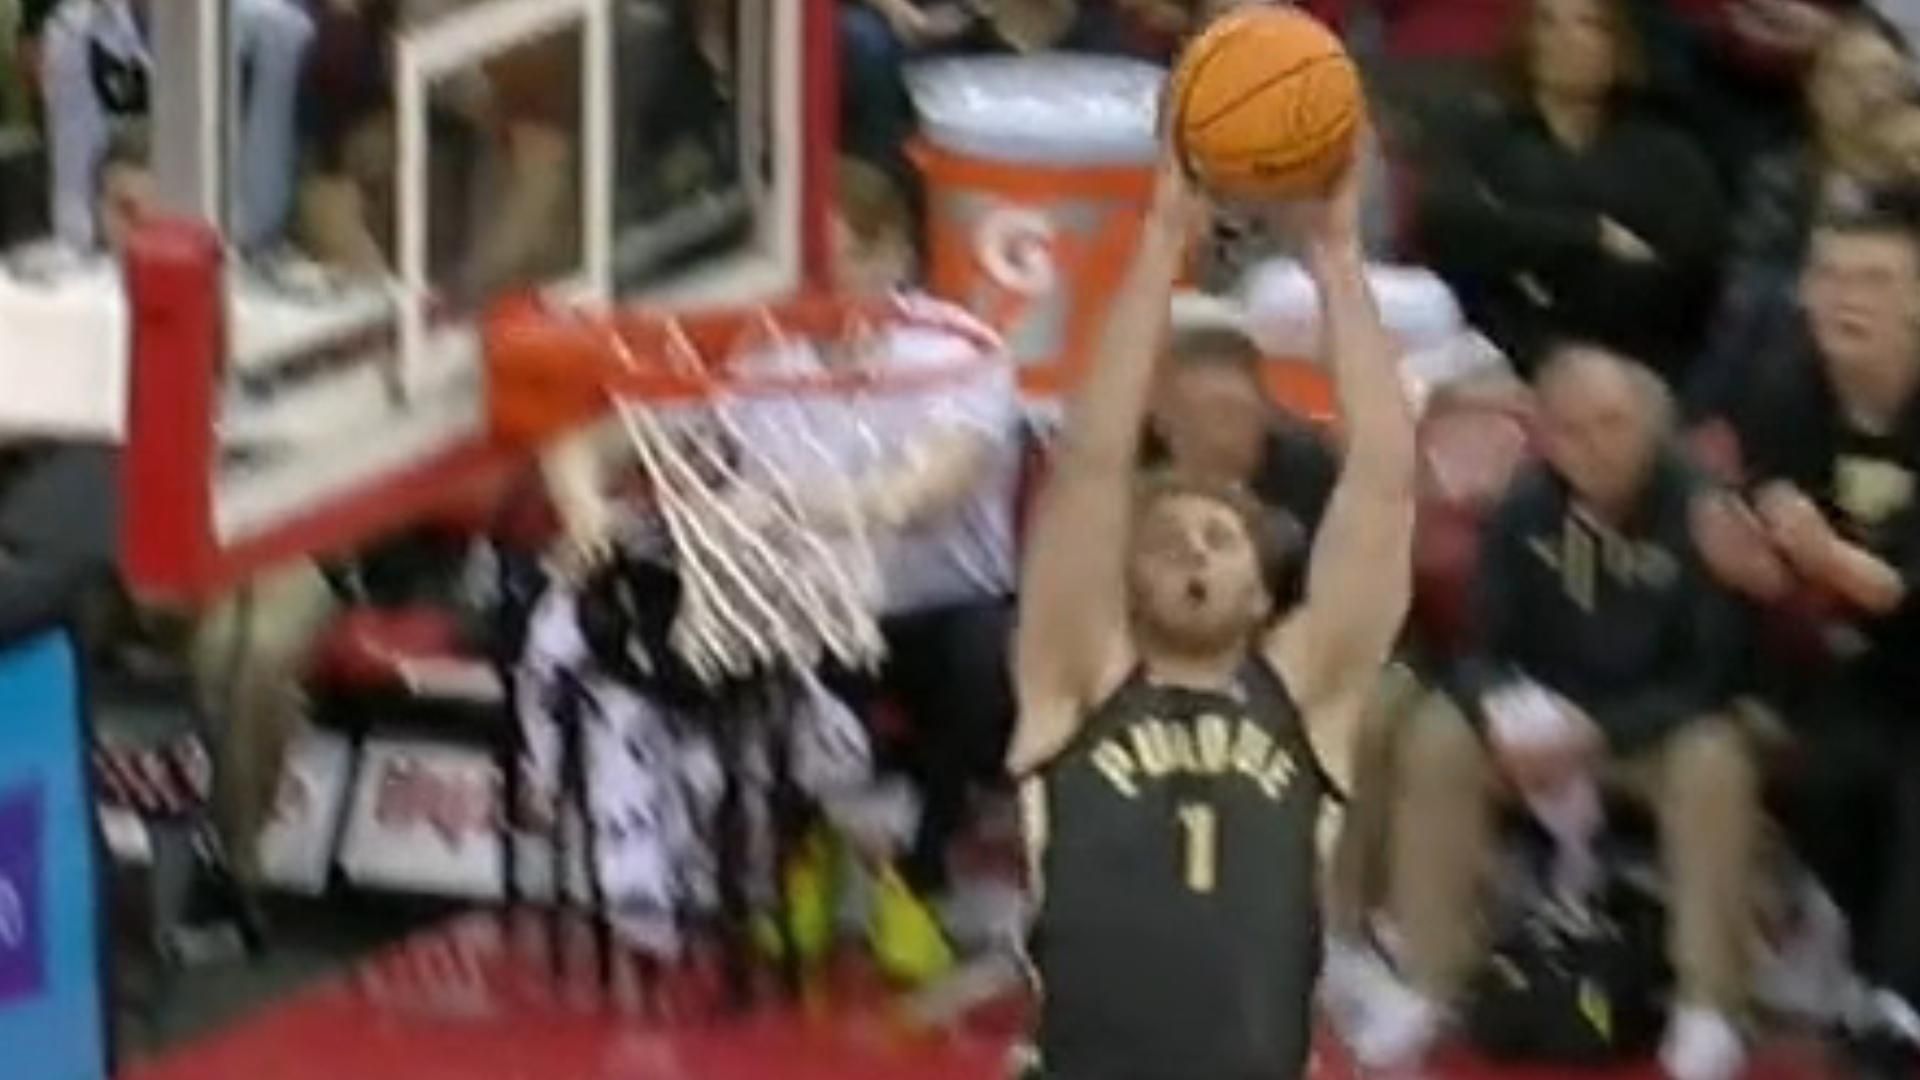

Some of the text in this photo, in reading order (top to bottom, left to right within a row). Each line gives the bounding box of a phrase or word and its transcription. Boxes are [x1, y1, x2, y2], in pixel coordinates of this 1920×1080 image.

[973, 208, 1055, 296] G
[1090, 713, 1299, 800] PURDUE
[1177, 803, 1217, 893] 1
